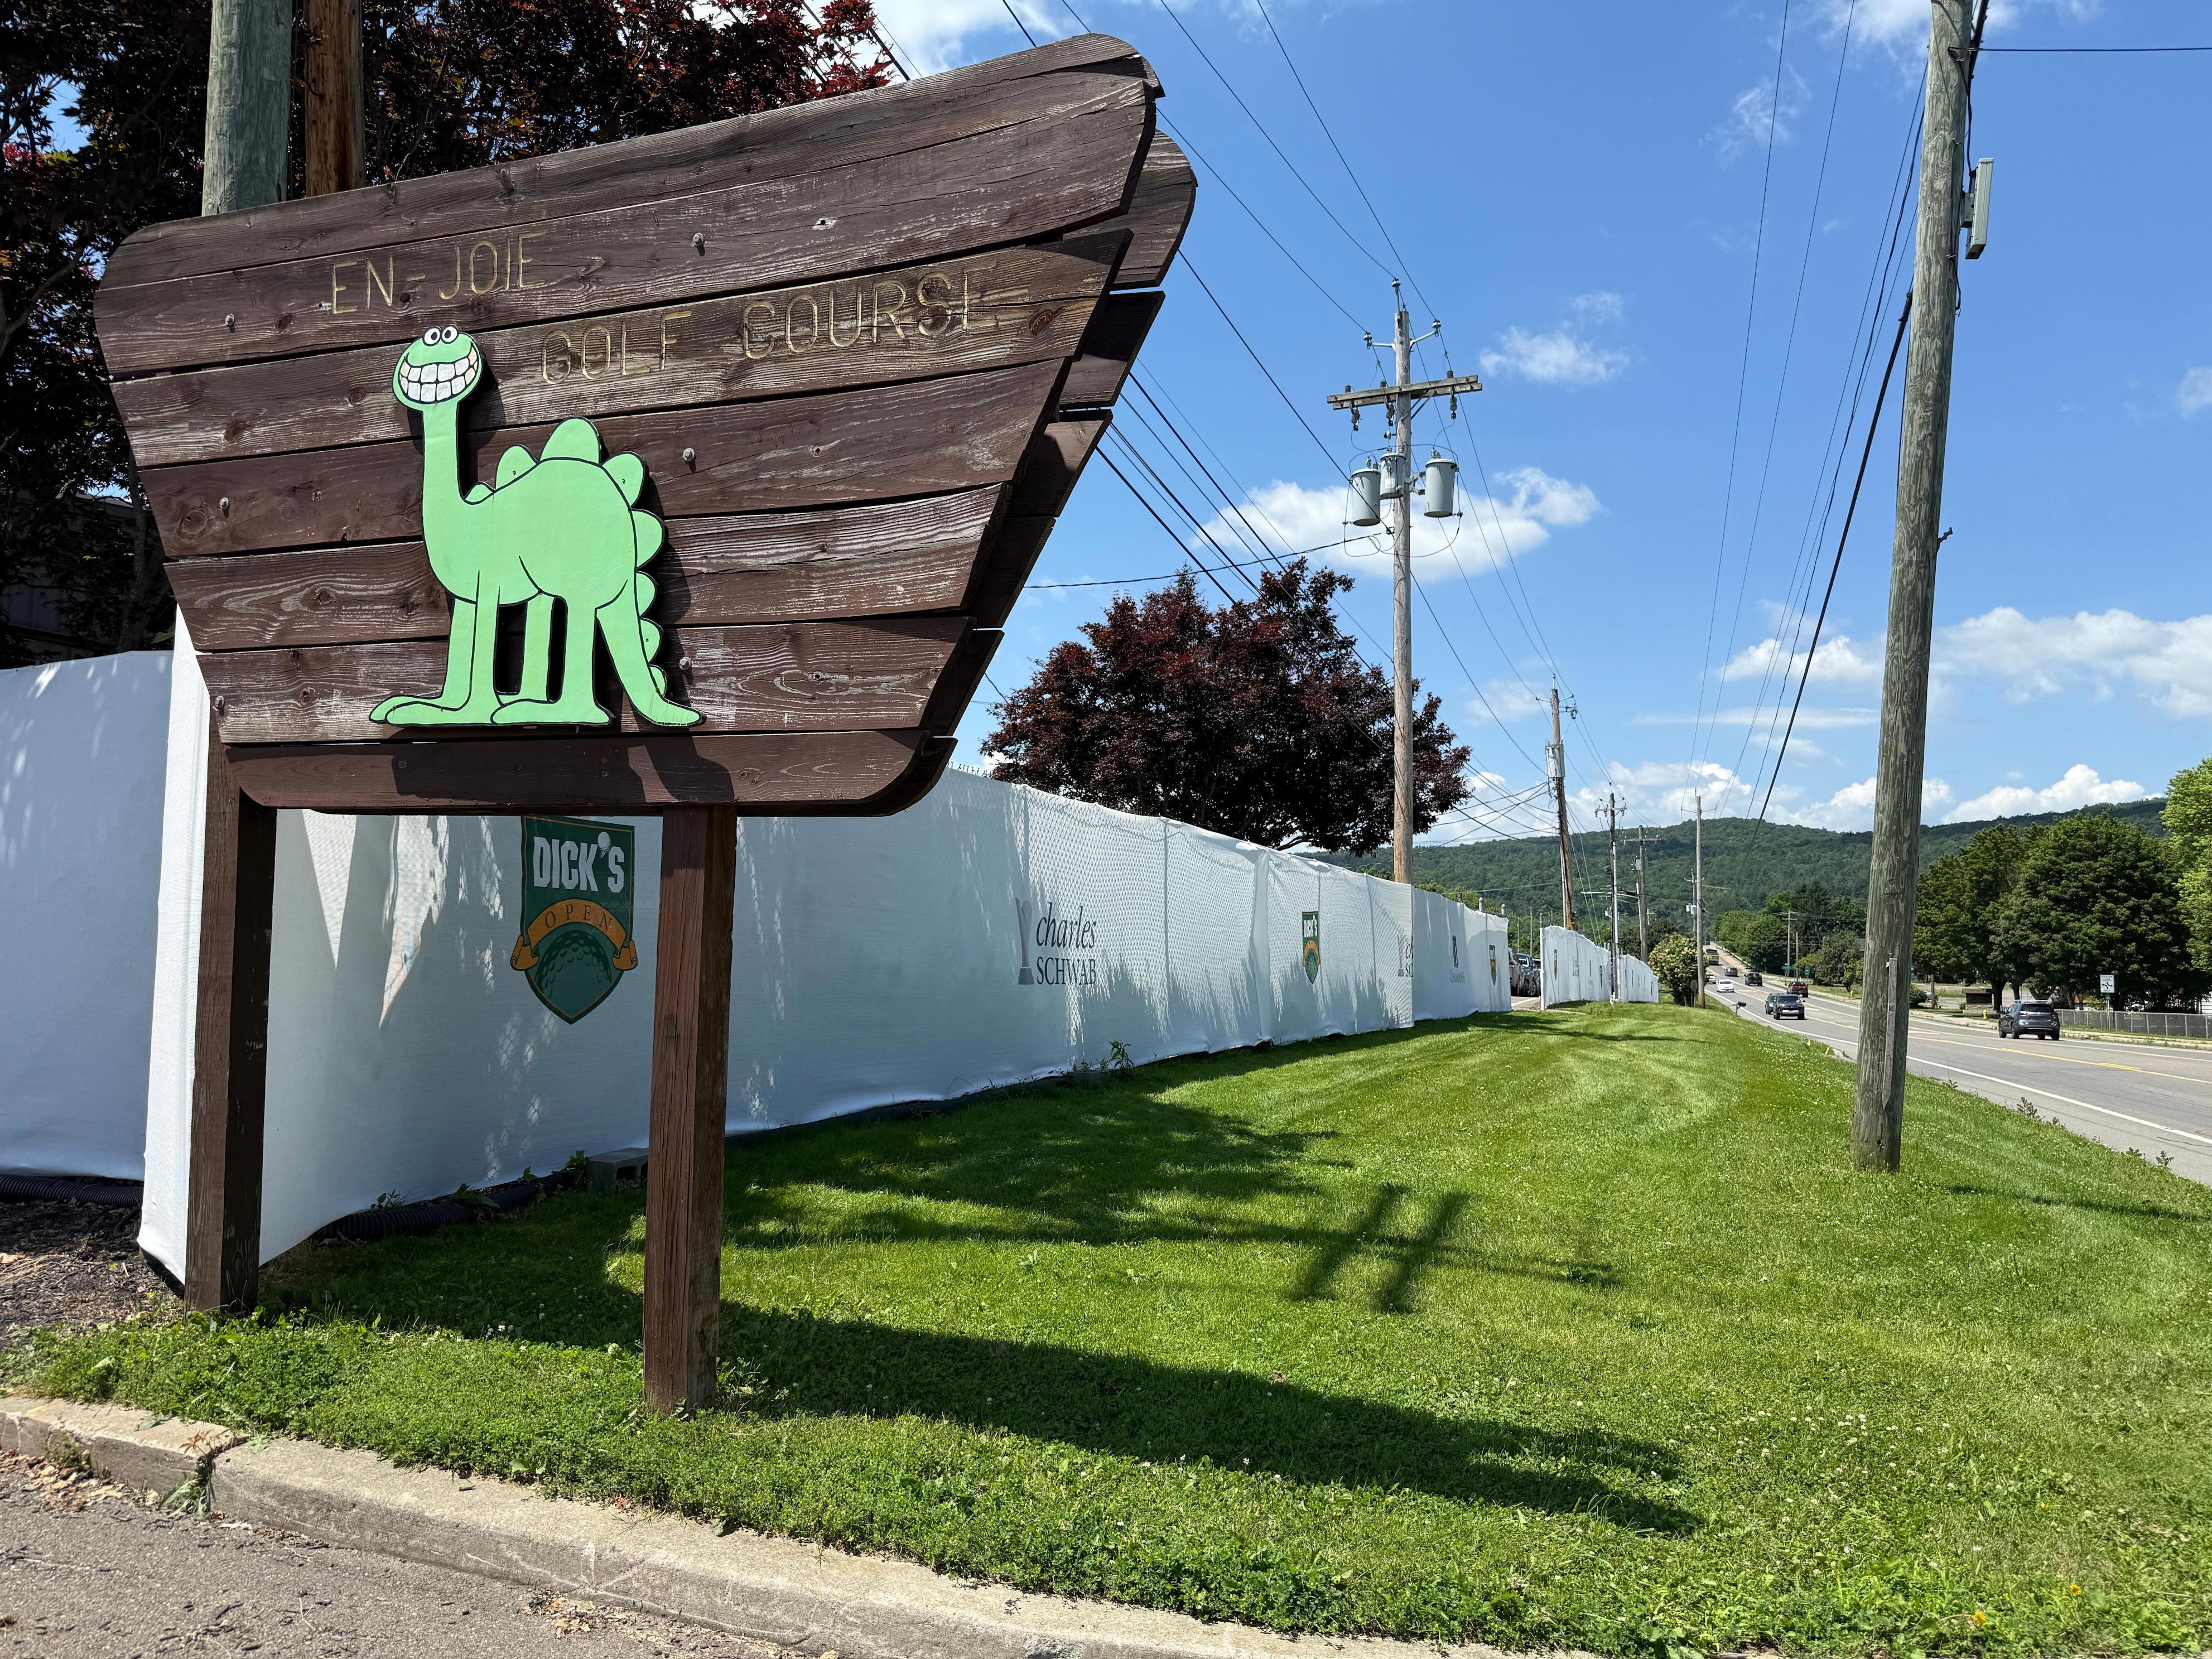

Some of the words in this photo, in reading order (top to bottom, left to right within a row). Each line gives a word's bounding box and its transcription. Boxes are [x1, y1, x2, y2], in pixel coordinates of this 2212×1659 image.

[332, 232, 547, 314] EN-JOIE
[542, 310, 692, 384] GOLF
[743, 261, 997, 359] COURSE
[533, 832, 625, 893] DICK'S
[544, 904, 613, 933] OPEN
[1036, 902, 1096, 949] charles
[1037, 956, 1097, 985] SCHWAB
